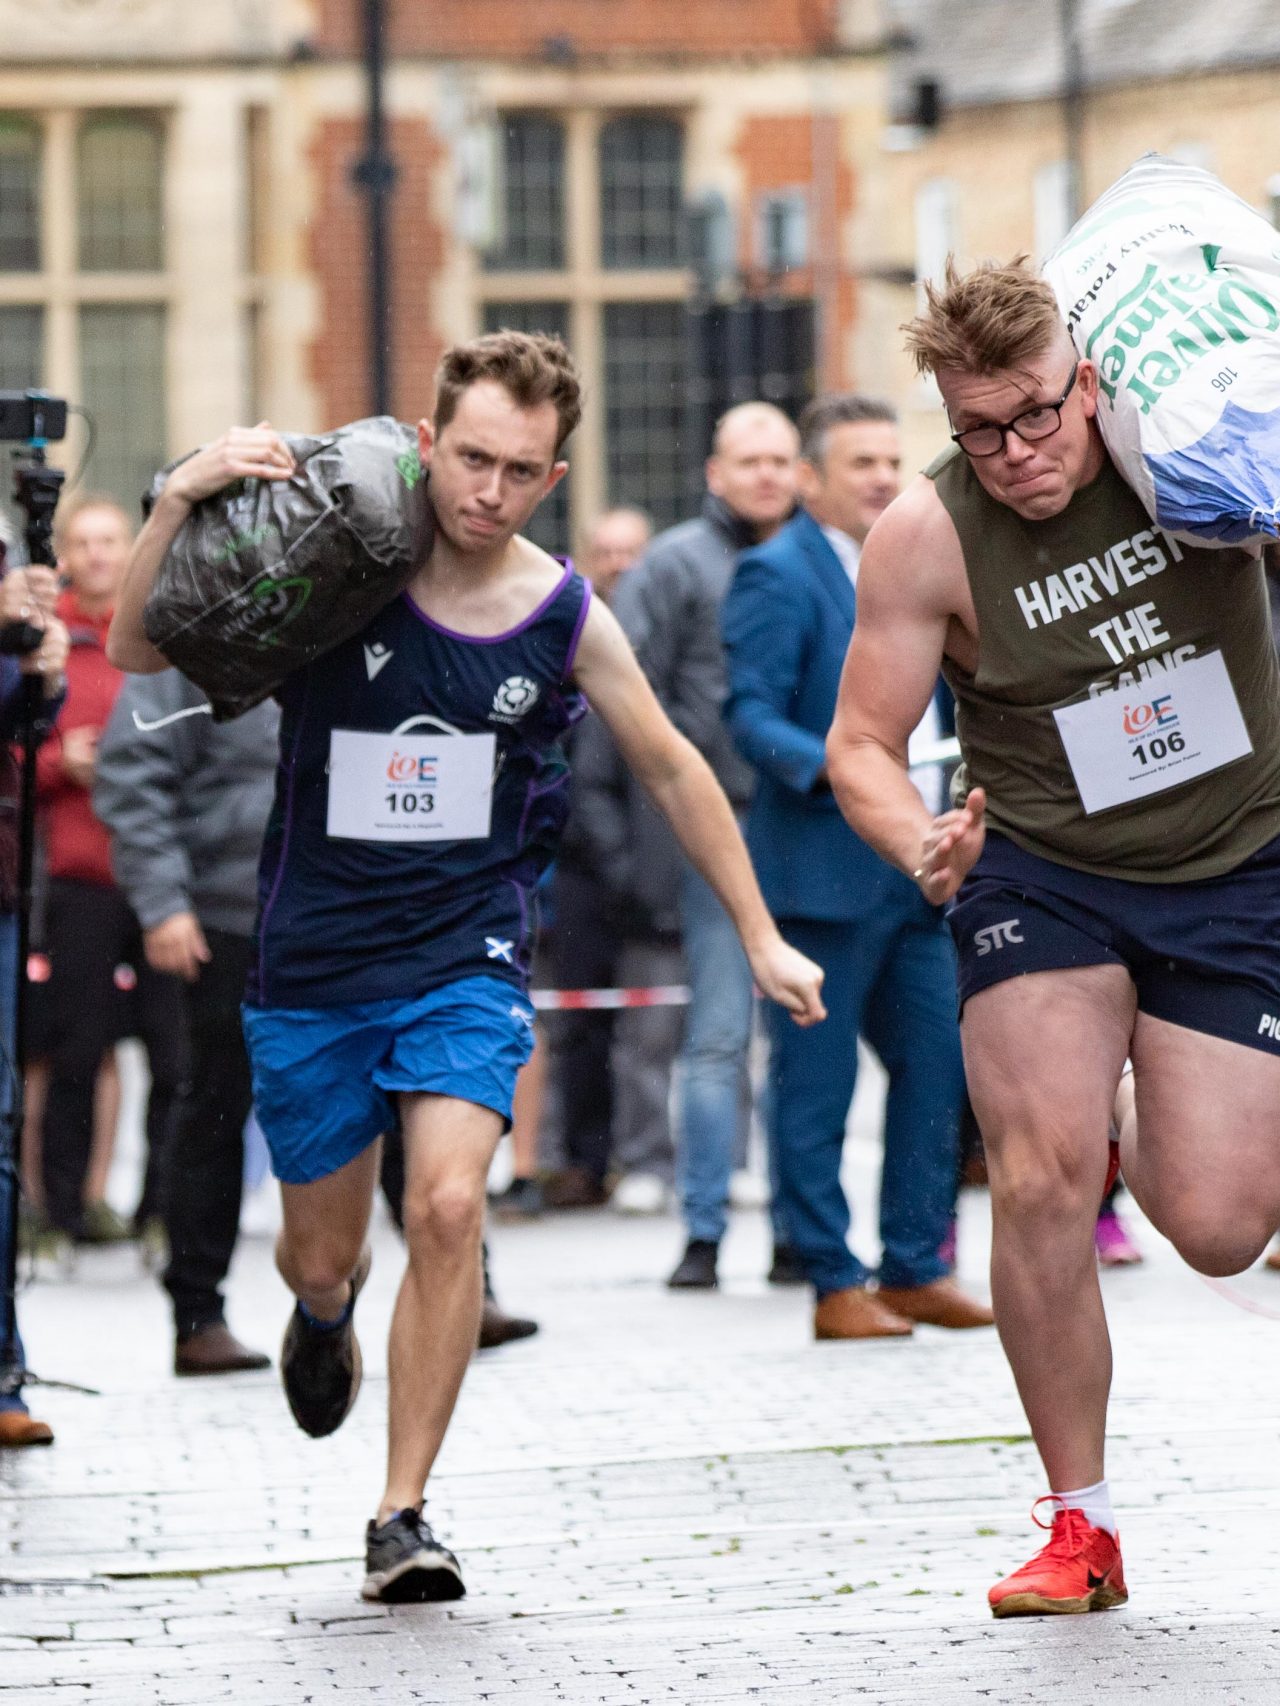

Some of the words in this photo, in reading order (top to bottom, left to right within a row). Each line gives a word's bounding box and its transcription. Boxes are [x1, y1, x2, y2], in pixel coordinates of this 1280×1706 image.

[1126, 280, 1280, 415] Oliver
[1211, 366, 1238, 392] 106
[1014, 526, 1184, 630] HARVEST
[1089, 602, 1170, 665] THE
[1132, 731, 1185, 765] 106
[385, 792, 435, 814] 103
[975, 918, 1024, 957] STC
